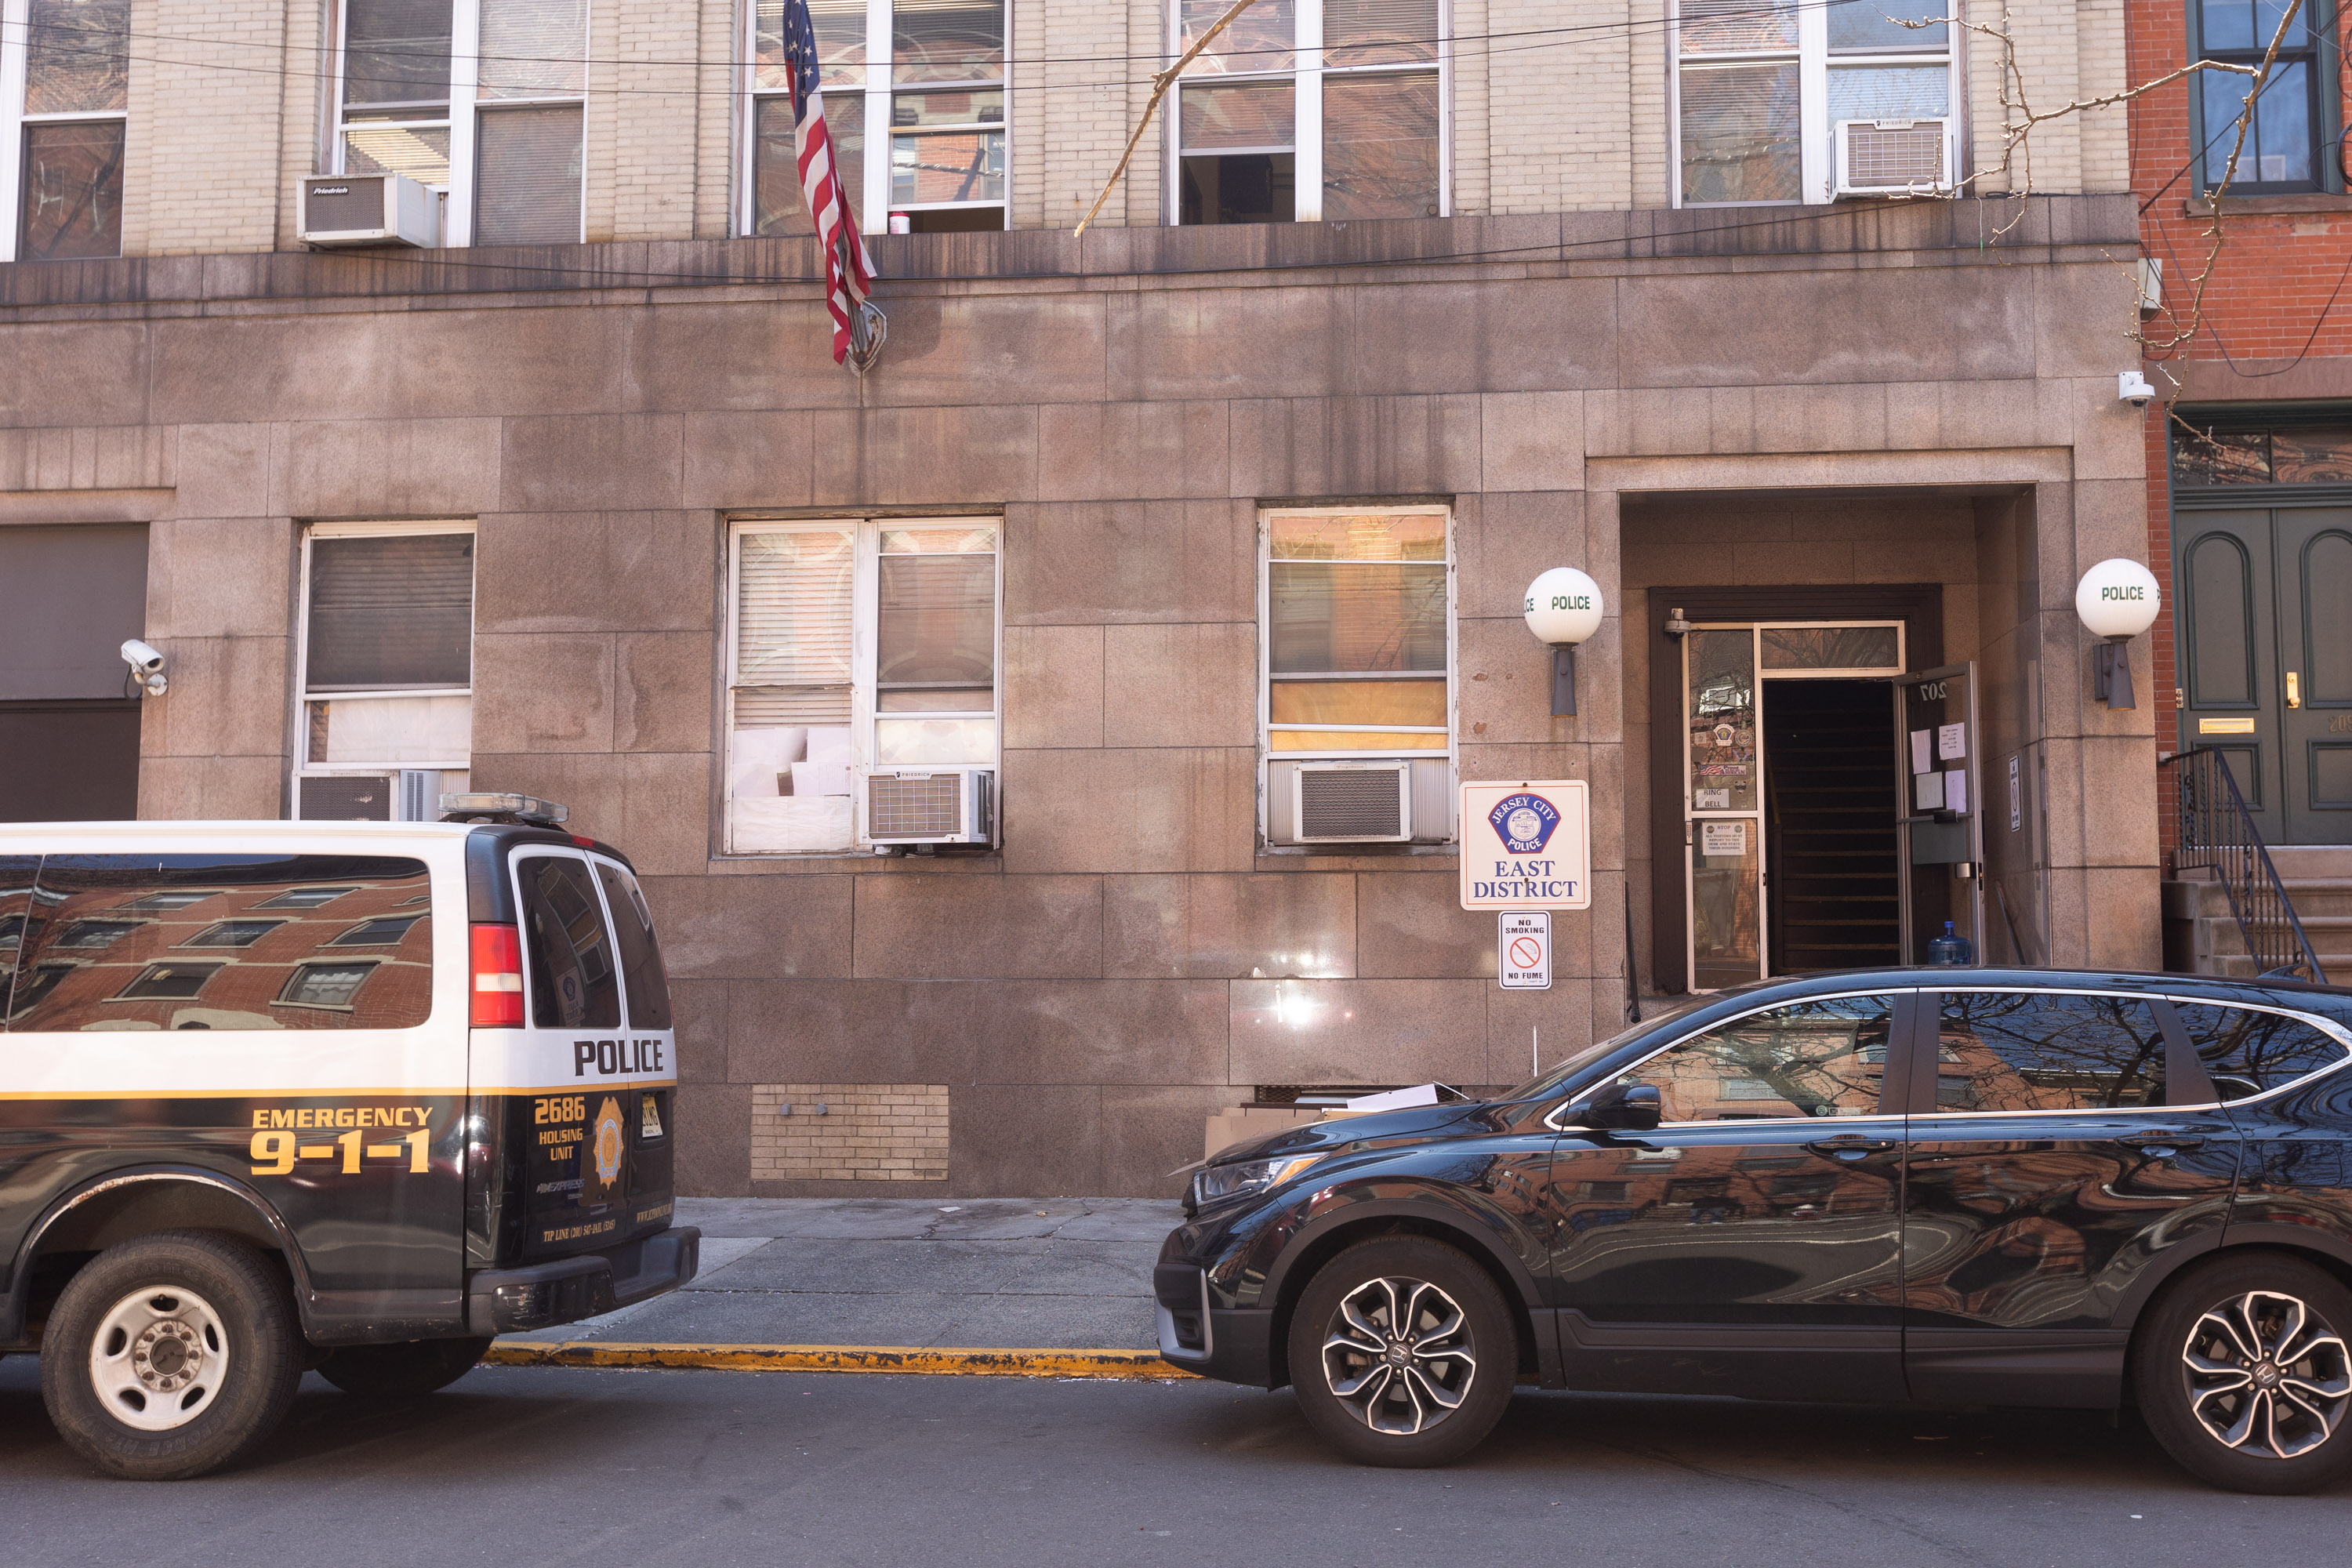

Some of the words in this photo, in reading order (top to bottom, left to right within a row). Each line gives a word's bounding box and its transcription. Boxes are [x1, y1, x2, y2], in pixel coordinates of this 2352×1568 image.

[2102, 586, 2143, 601] POLICE
[1552, 596, 1590, 610] POLICE
[1492, 797, 1530, 823] JERSEY
[1533, 800, 1556, 822] CITY
[1508, 837, 1542, 851] POLICE
[1494, 860, 1555, 877] EAST
[1473, 880, 1577, 898] DISTRICT
[574, 1040, 663, 1076] POLICE
[252, 1106, 433, 1129] EMERGENCY
[535, 1096, 586, 1124] 2686
[539, 1128, 583, 1145] HOUSING
[250, 1128, 430, 1175] 9-1-1
[550, 1145, 573, 1161] UNIT
[543, 1230, 554, 1242] TIP
[555, 1228, 569, 1240] LINE
